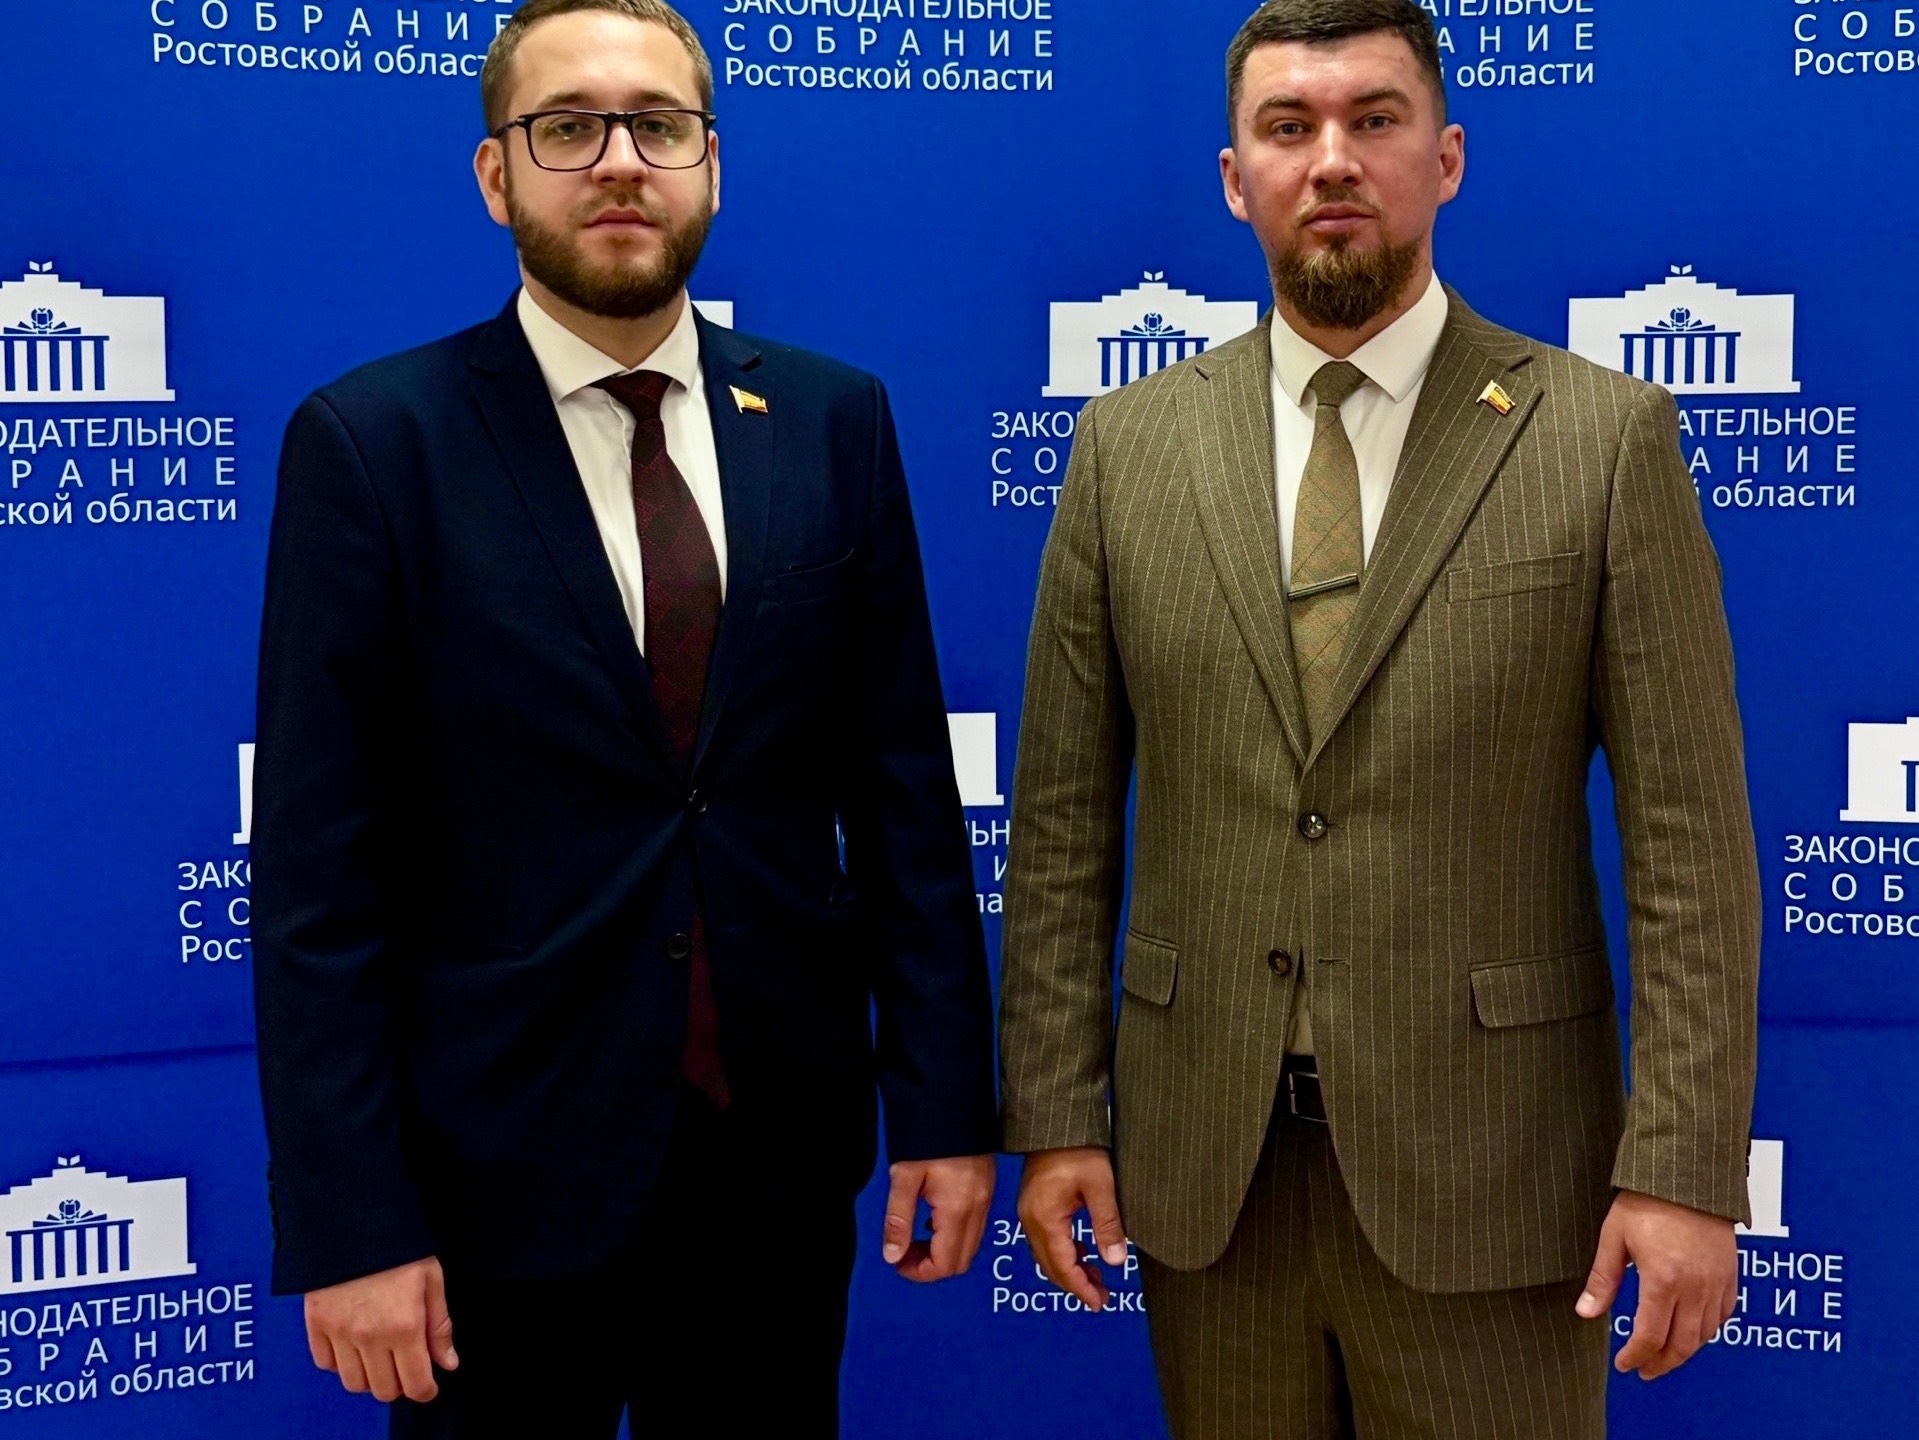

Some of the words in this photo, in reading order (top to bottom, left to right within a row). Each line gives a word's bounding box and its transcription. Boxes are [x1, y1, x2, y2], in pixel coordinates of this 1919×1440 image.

[153, 32, 362, 73] Ростовской
[374, 44, 488, 77] облас
[724, 23, 1052, 57] СОБРАНИЕ
[726, 57, 911, 90] Ростовской
[922, 61, 1053, 91] области
[1456, 58, 1594, 87] области
[1794, 48, 1919, 76] Ростов
[0, 417, 235, 455] ДАТЕЛЬНОЕ
[991, 410, 1081, 439] ЗАКО
[86, 492, 236, 524] области
[1712, 478, 1855, 508] области
[178, 859, 251, 891] ЗАК
[1707, 1317, 1842, 1353] бласти
[110, 1359, 255, 1396] области
